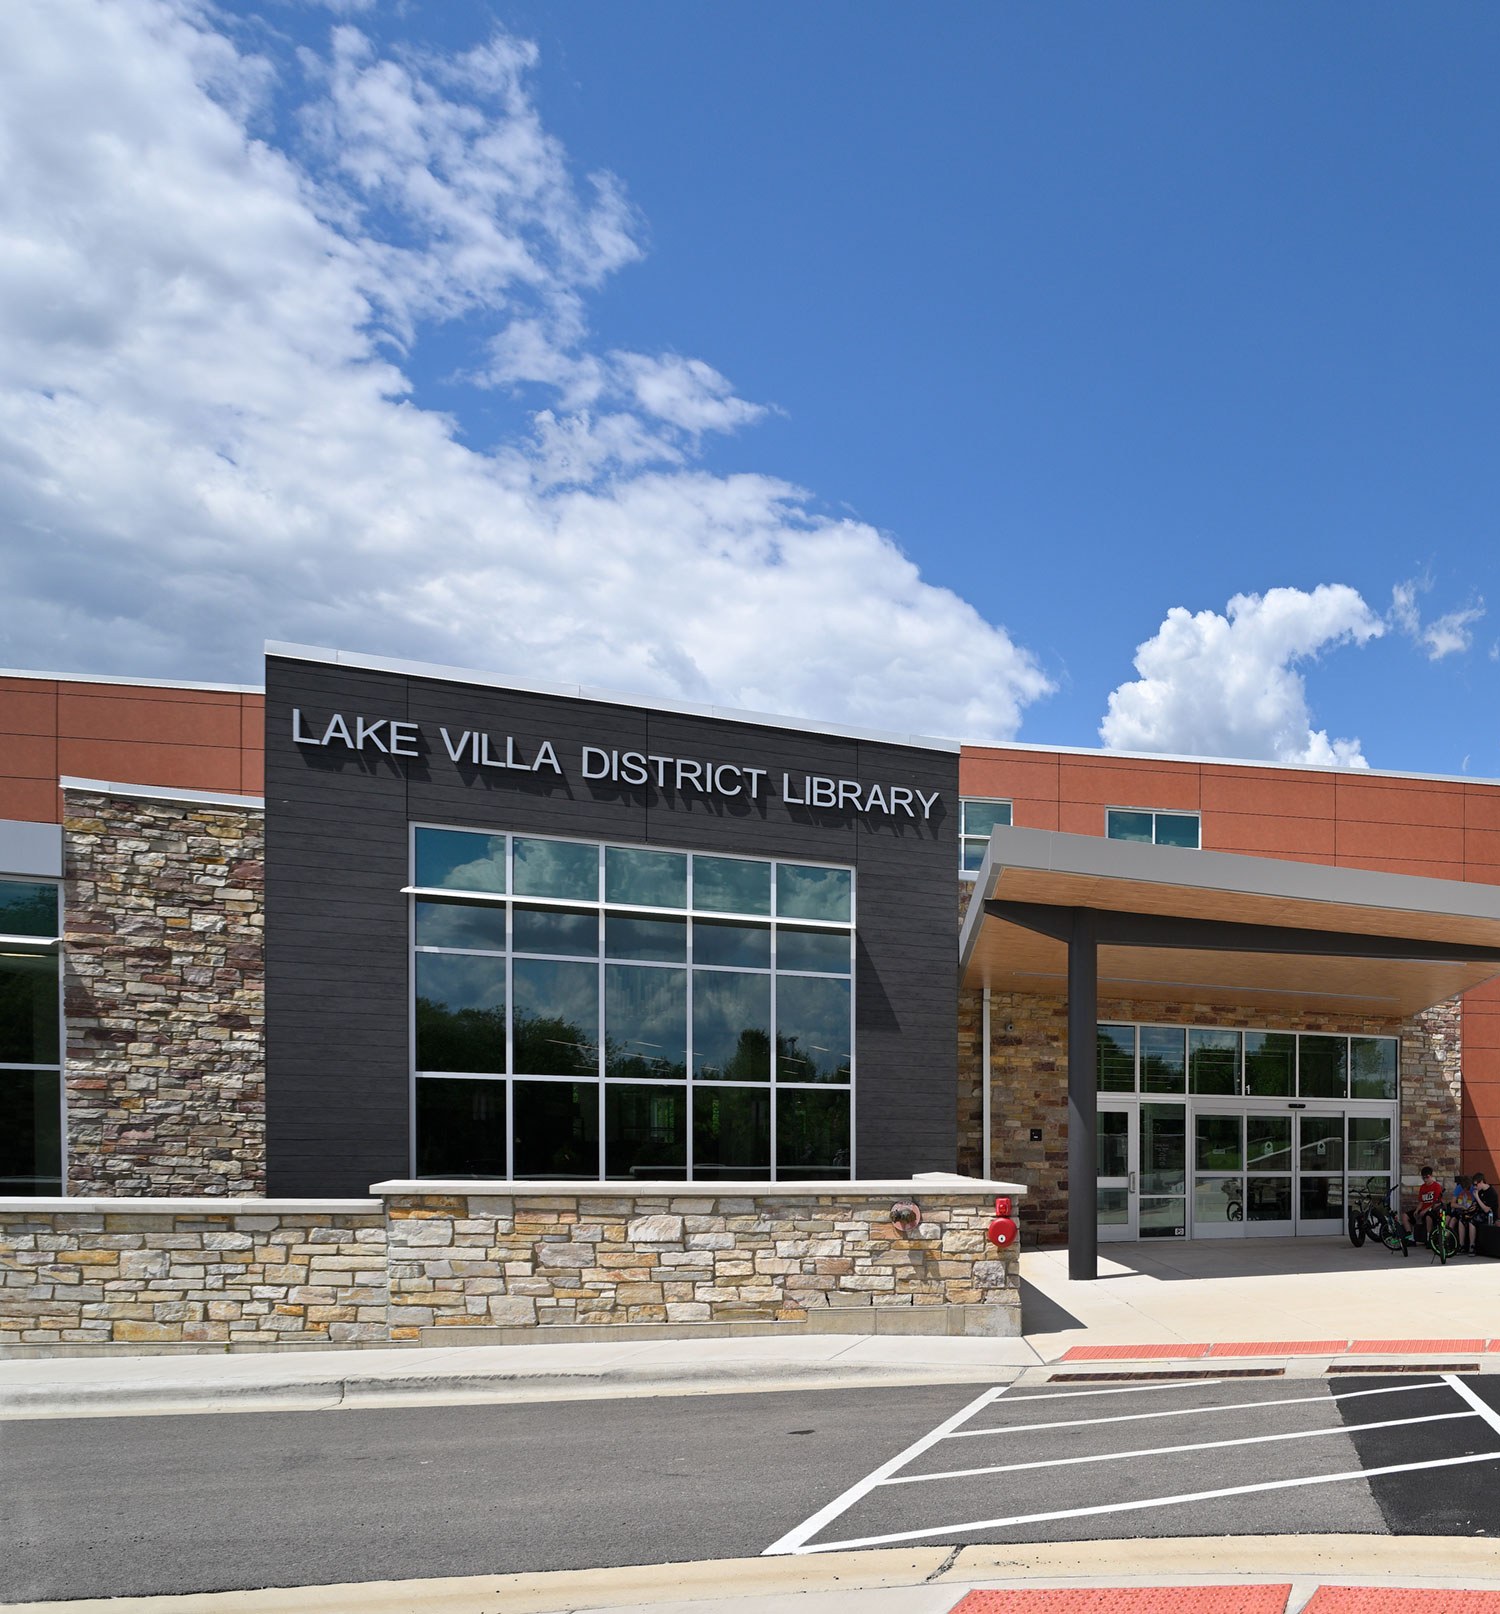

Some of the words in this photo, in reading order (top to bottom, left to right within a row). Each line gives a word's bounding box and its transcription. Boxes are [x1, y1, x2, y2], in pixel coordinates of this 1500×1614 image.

[292, 708, 419, 757] LAKE
[439, 727, 562, 774] VILLA
[582, 746, 768, 799] DISTRICT
[783, 772, 940, 820] LIBRARY
